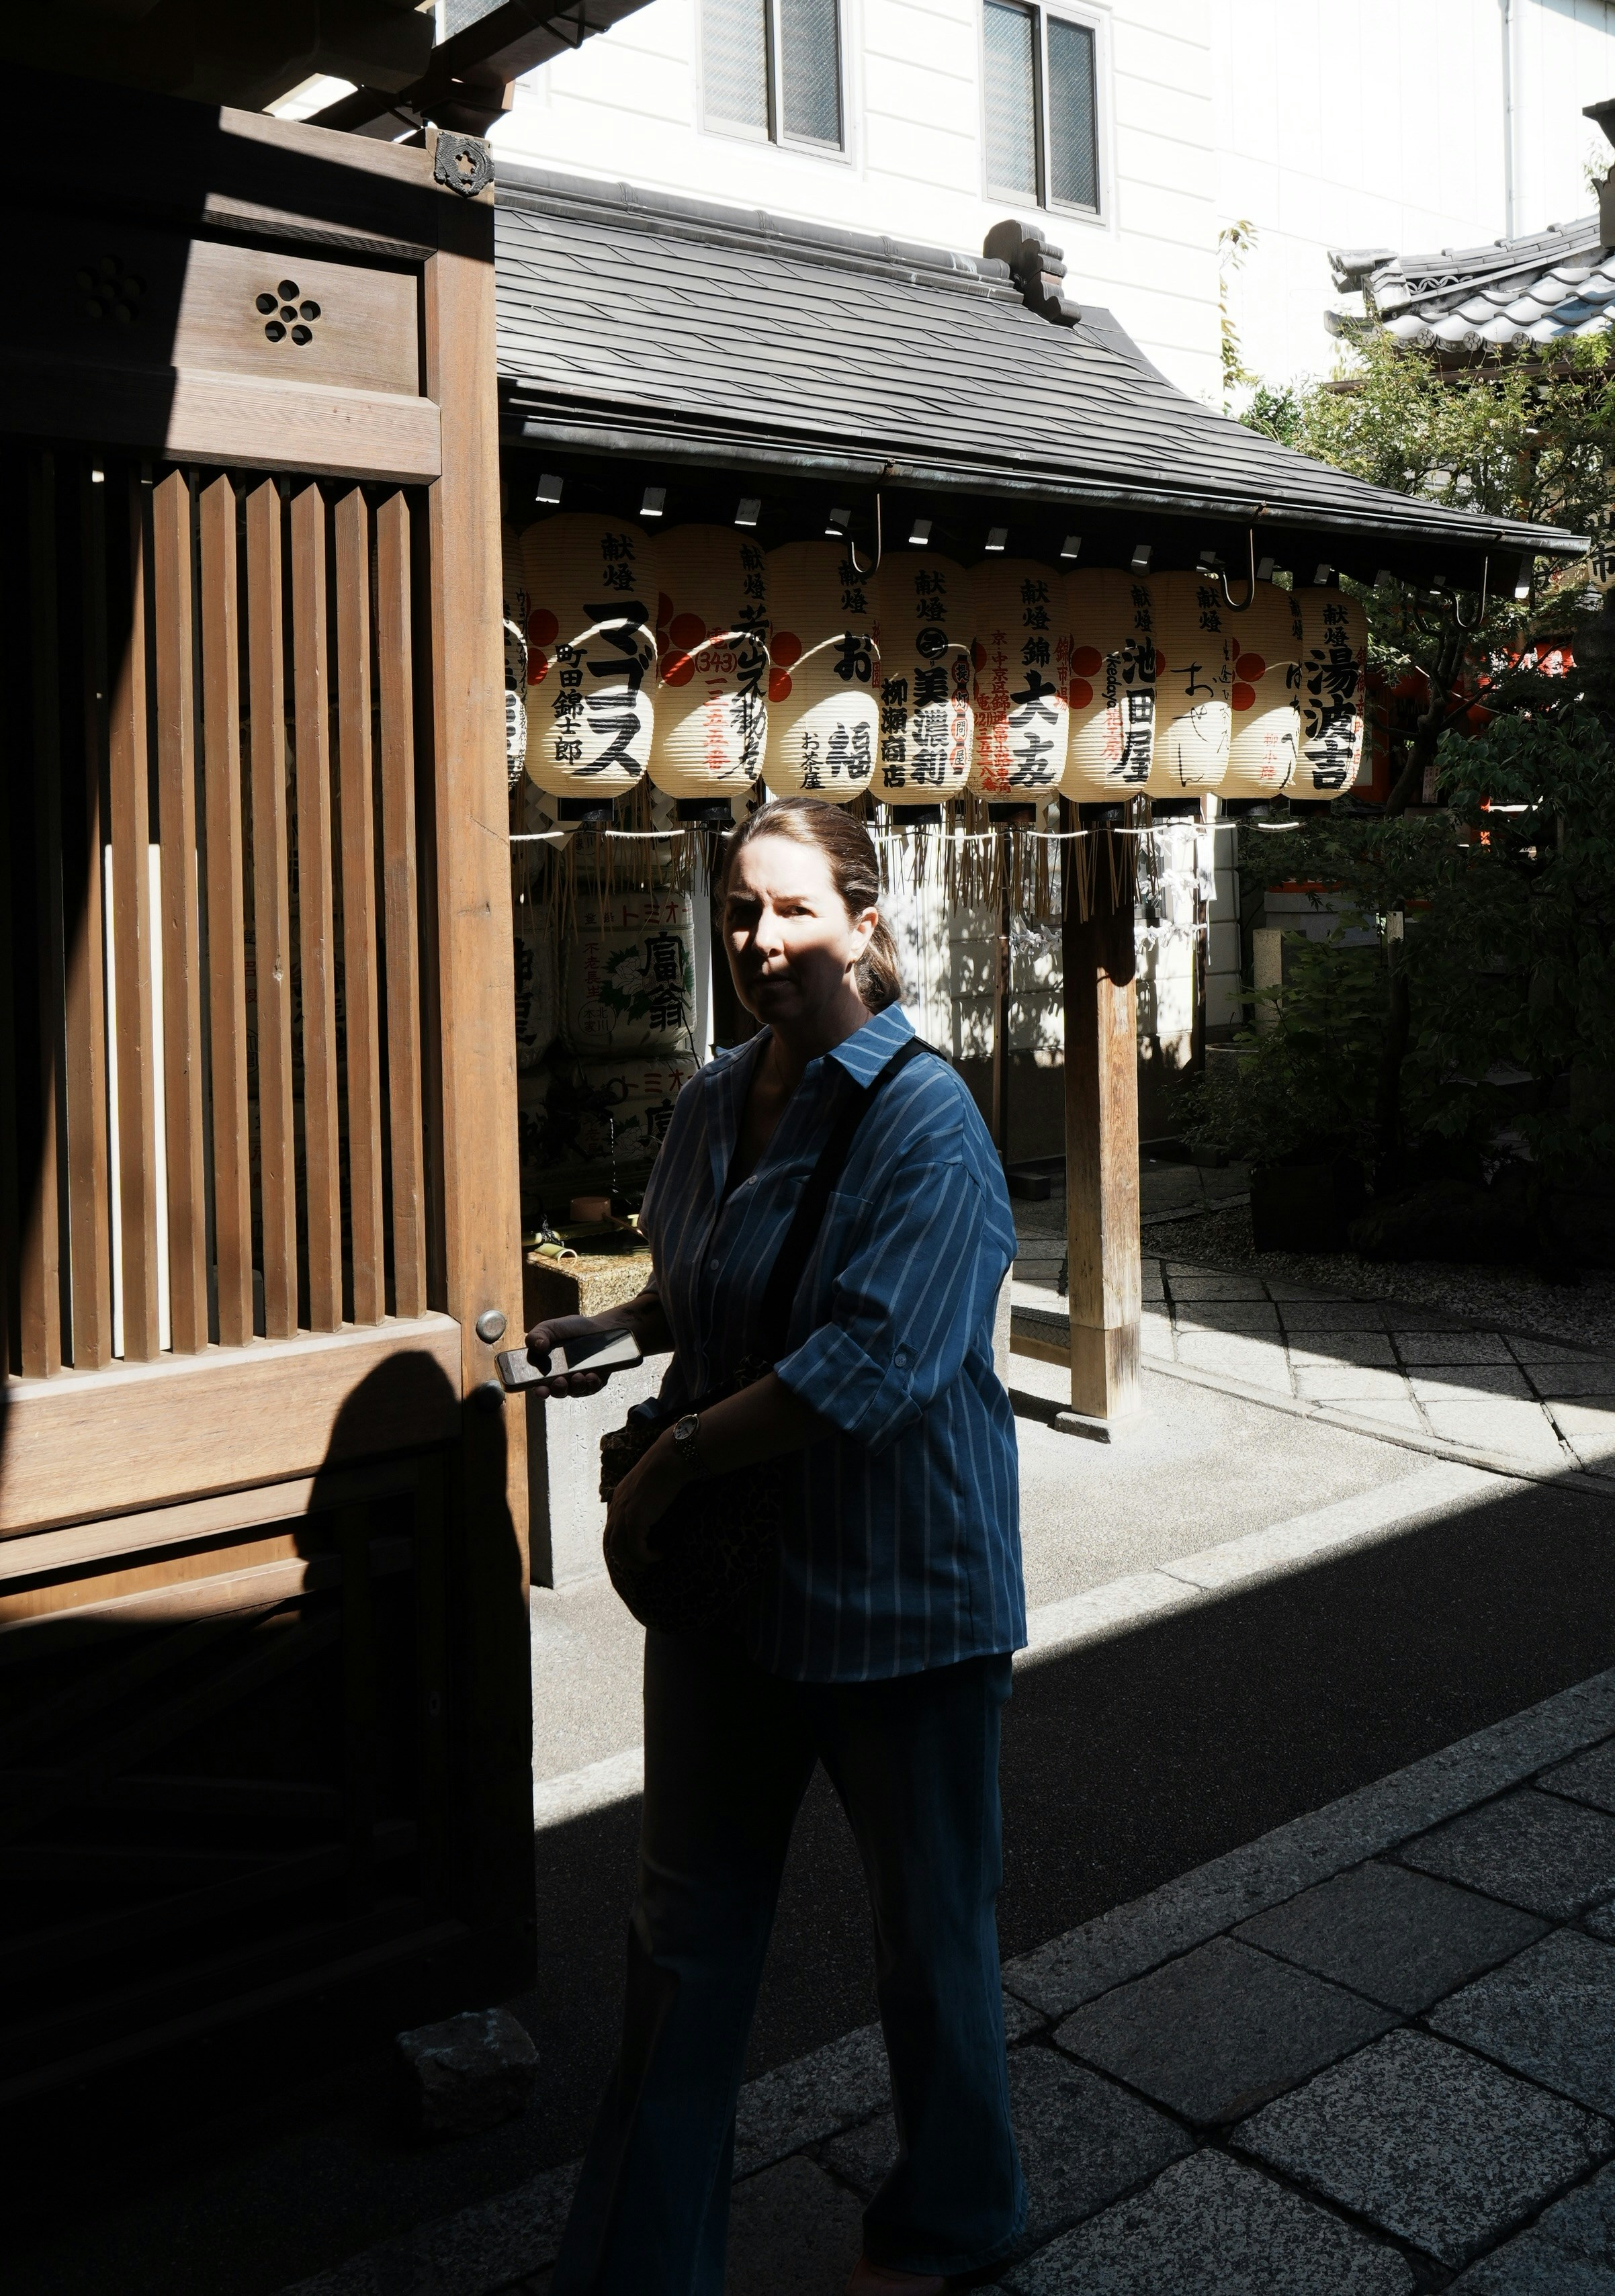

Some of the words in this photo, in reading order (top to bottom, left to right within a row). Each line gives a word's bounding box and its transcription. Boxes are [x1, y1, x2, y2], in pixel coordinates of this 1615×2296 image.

[601, 533, 636, 592] 献燈
[740, 544, 767, 601] 献燈
[914, 570, 949, 622] 献燈
[1020, 578, 1052, 631] 献燈
[1131, 583, 1152, 633] 献燈
[1196, 586, 1221, 633] 献燈
[1323, 603, 1350, 647] 献燈
[572, 601, 649, 778] マゴス
[1053, 635, 1069, 712] 錦市場
[1101, 652, 1124, 709] ikedaya
[551, 644, 587, 764] 町田錦士郎
[910, 666, 951, 785] 美濃利
[1109, 635, 1156, 783] 池田屋
[1303, 647, 1360, 790] 湯波吉
[799, 732, 826, 790] お茶屋
[881, 678, 908, 788] 柳瀬商店
[582, 942, 601, 998] 不老長生
[637, 931, 685, 1032] 富翁
[583, 1009, 596, 1032] 本家
[596, 1007, 609, 1032] 北川
